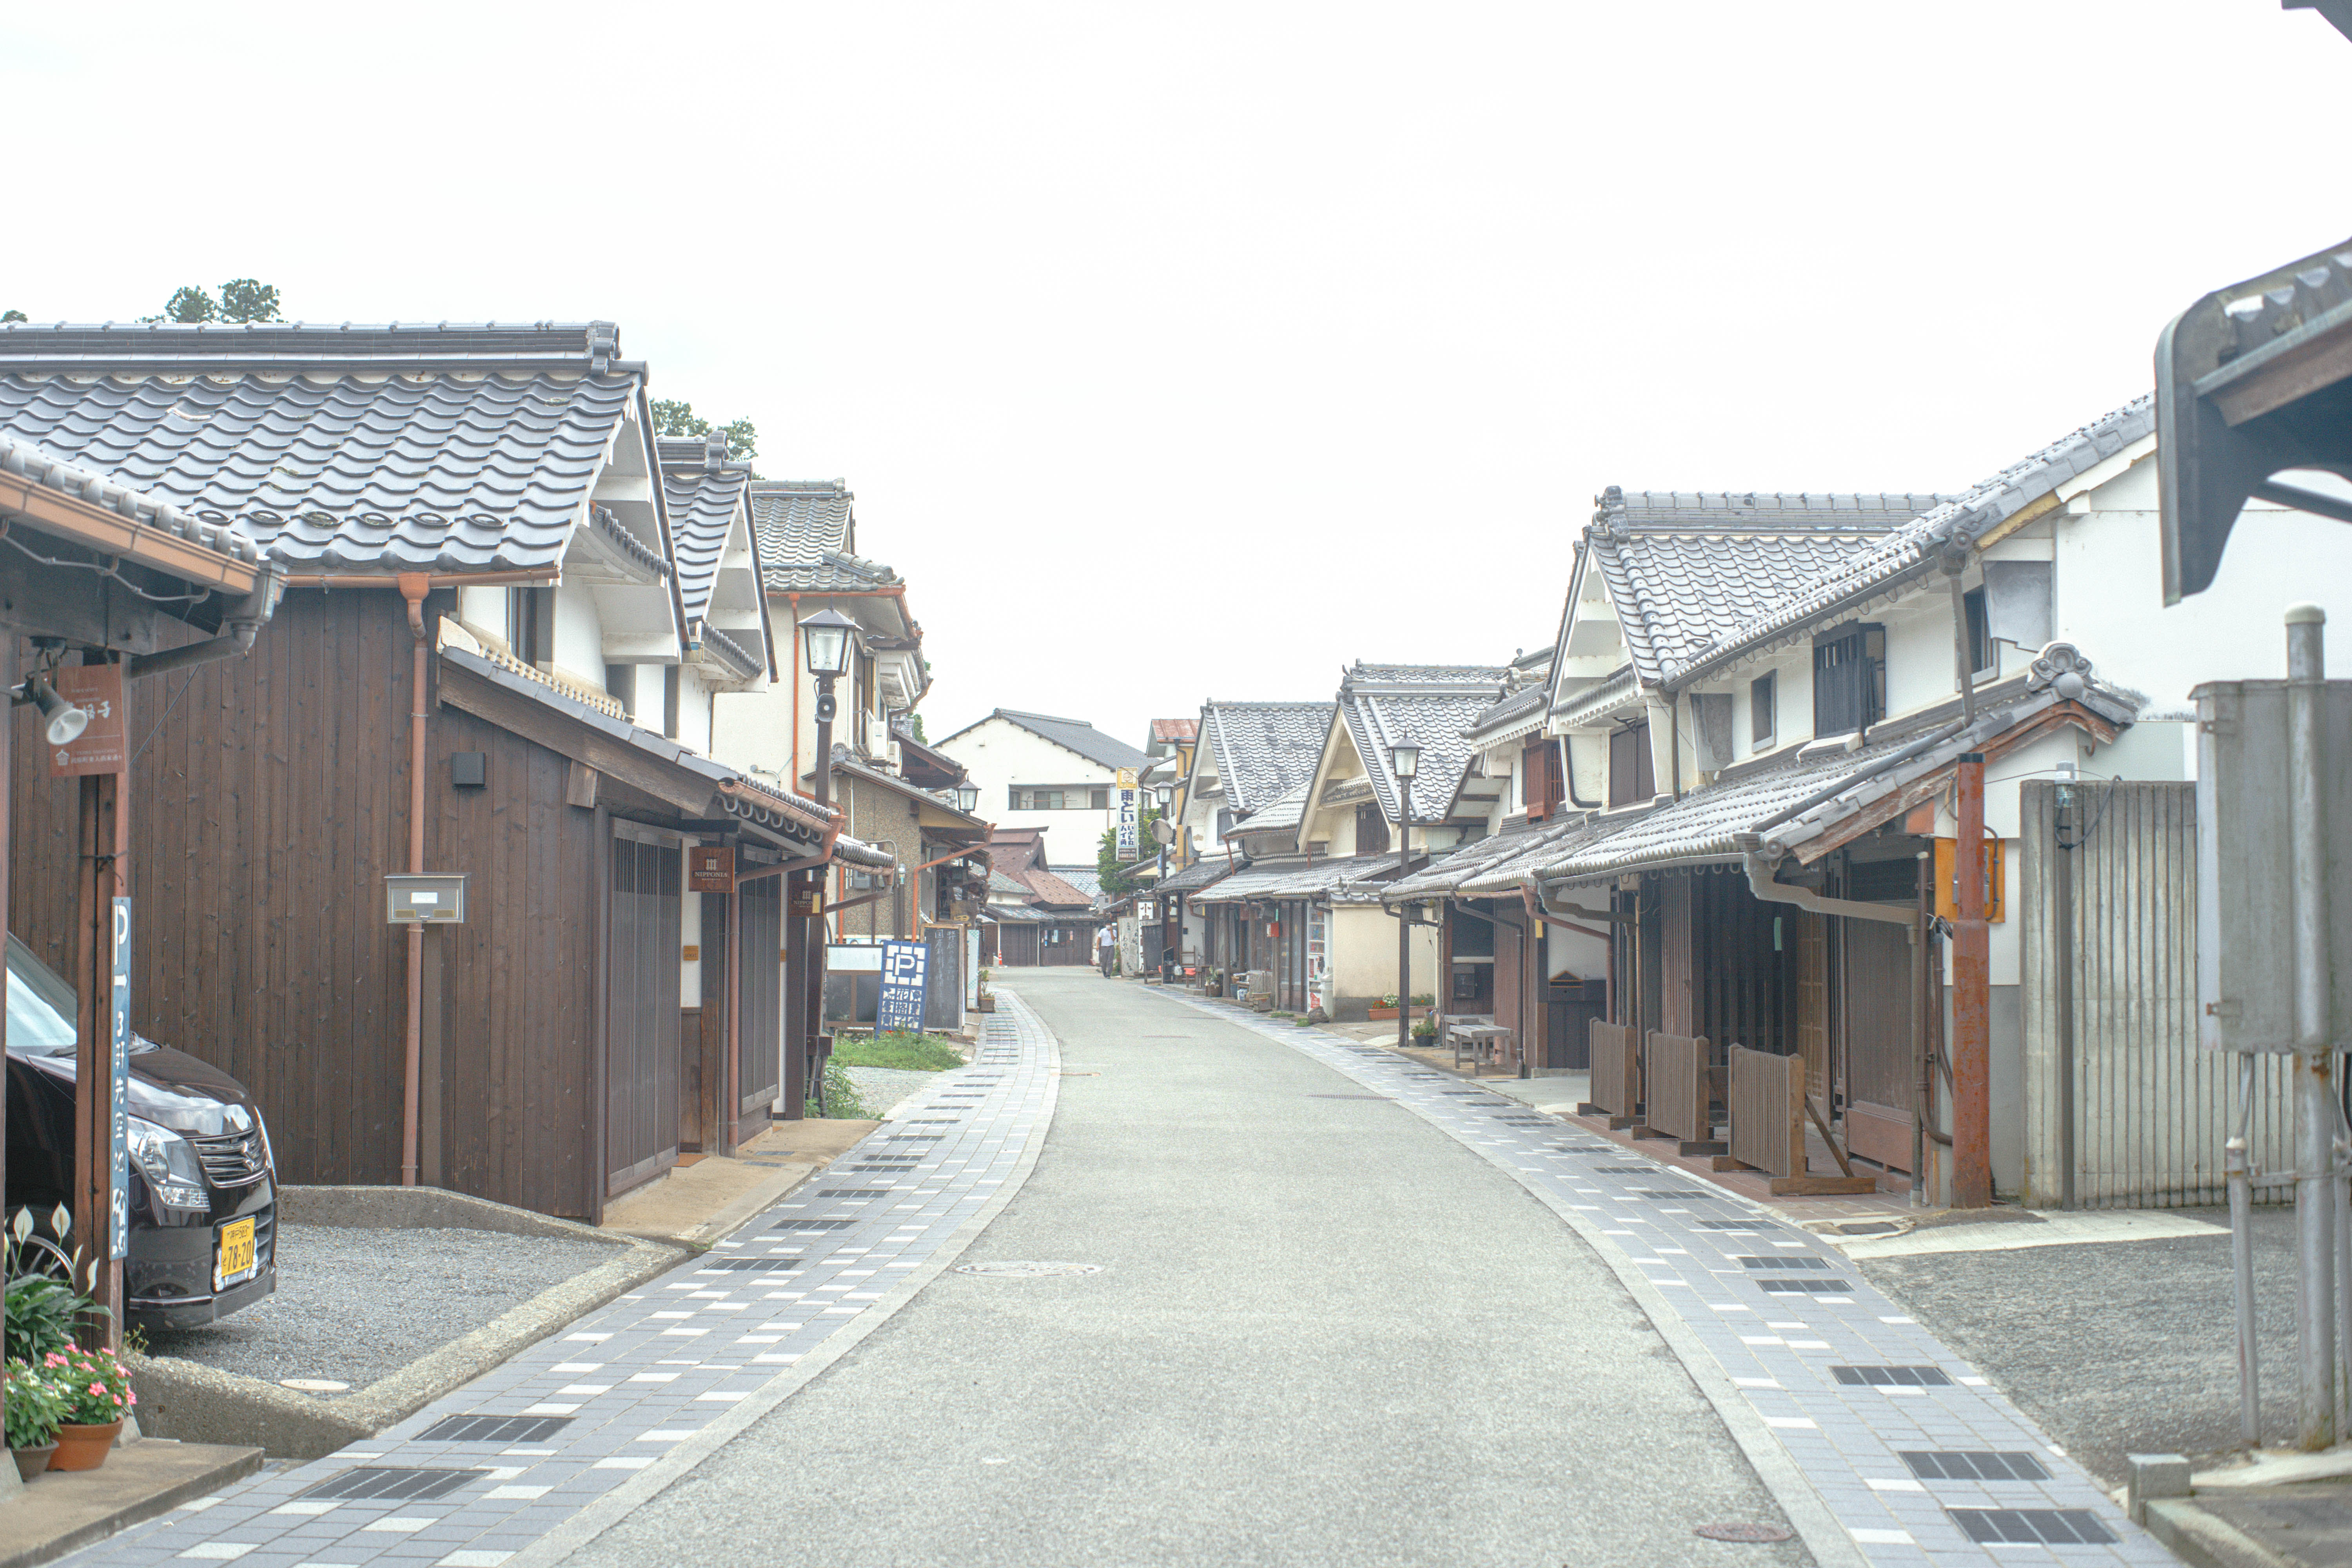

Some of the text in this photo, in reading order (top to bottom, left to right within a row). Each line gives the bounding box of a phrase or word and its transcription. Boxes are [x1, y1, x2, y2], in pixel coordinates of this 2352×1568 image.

[1121, 790, 1134, 823] 雨とい
[113, 905, 129, 965] P
[895, 954, 915, 976] P
[894, 988, 909, 1026] 花格子
[228, 1240, 251, 1271] 78-20
